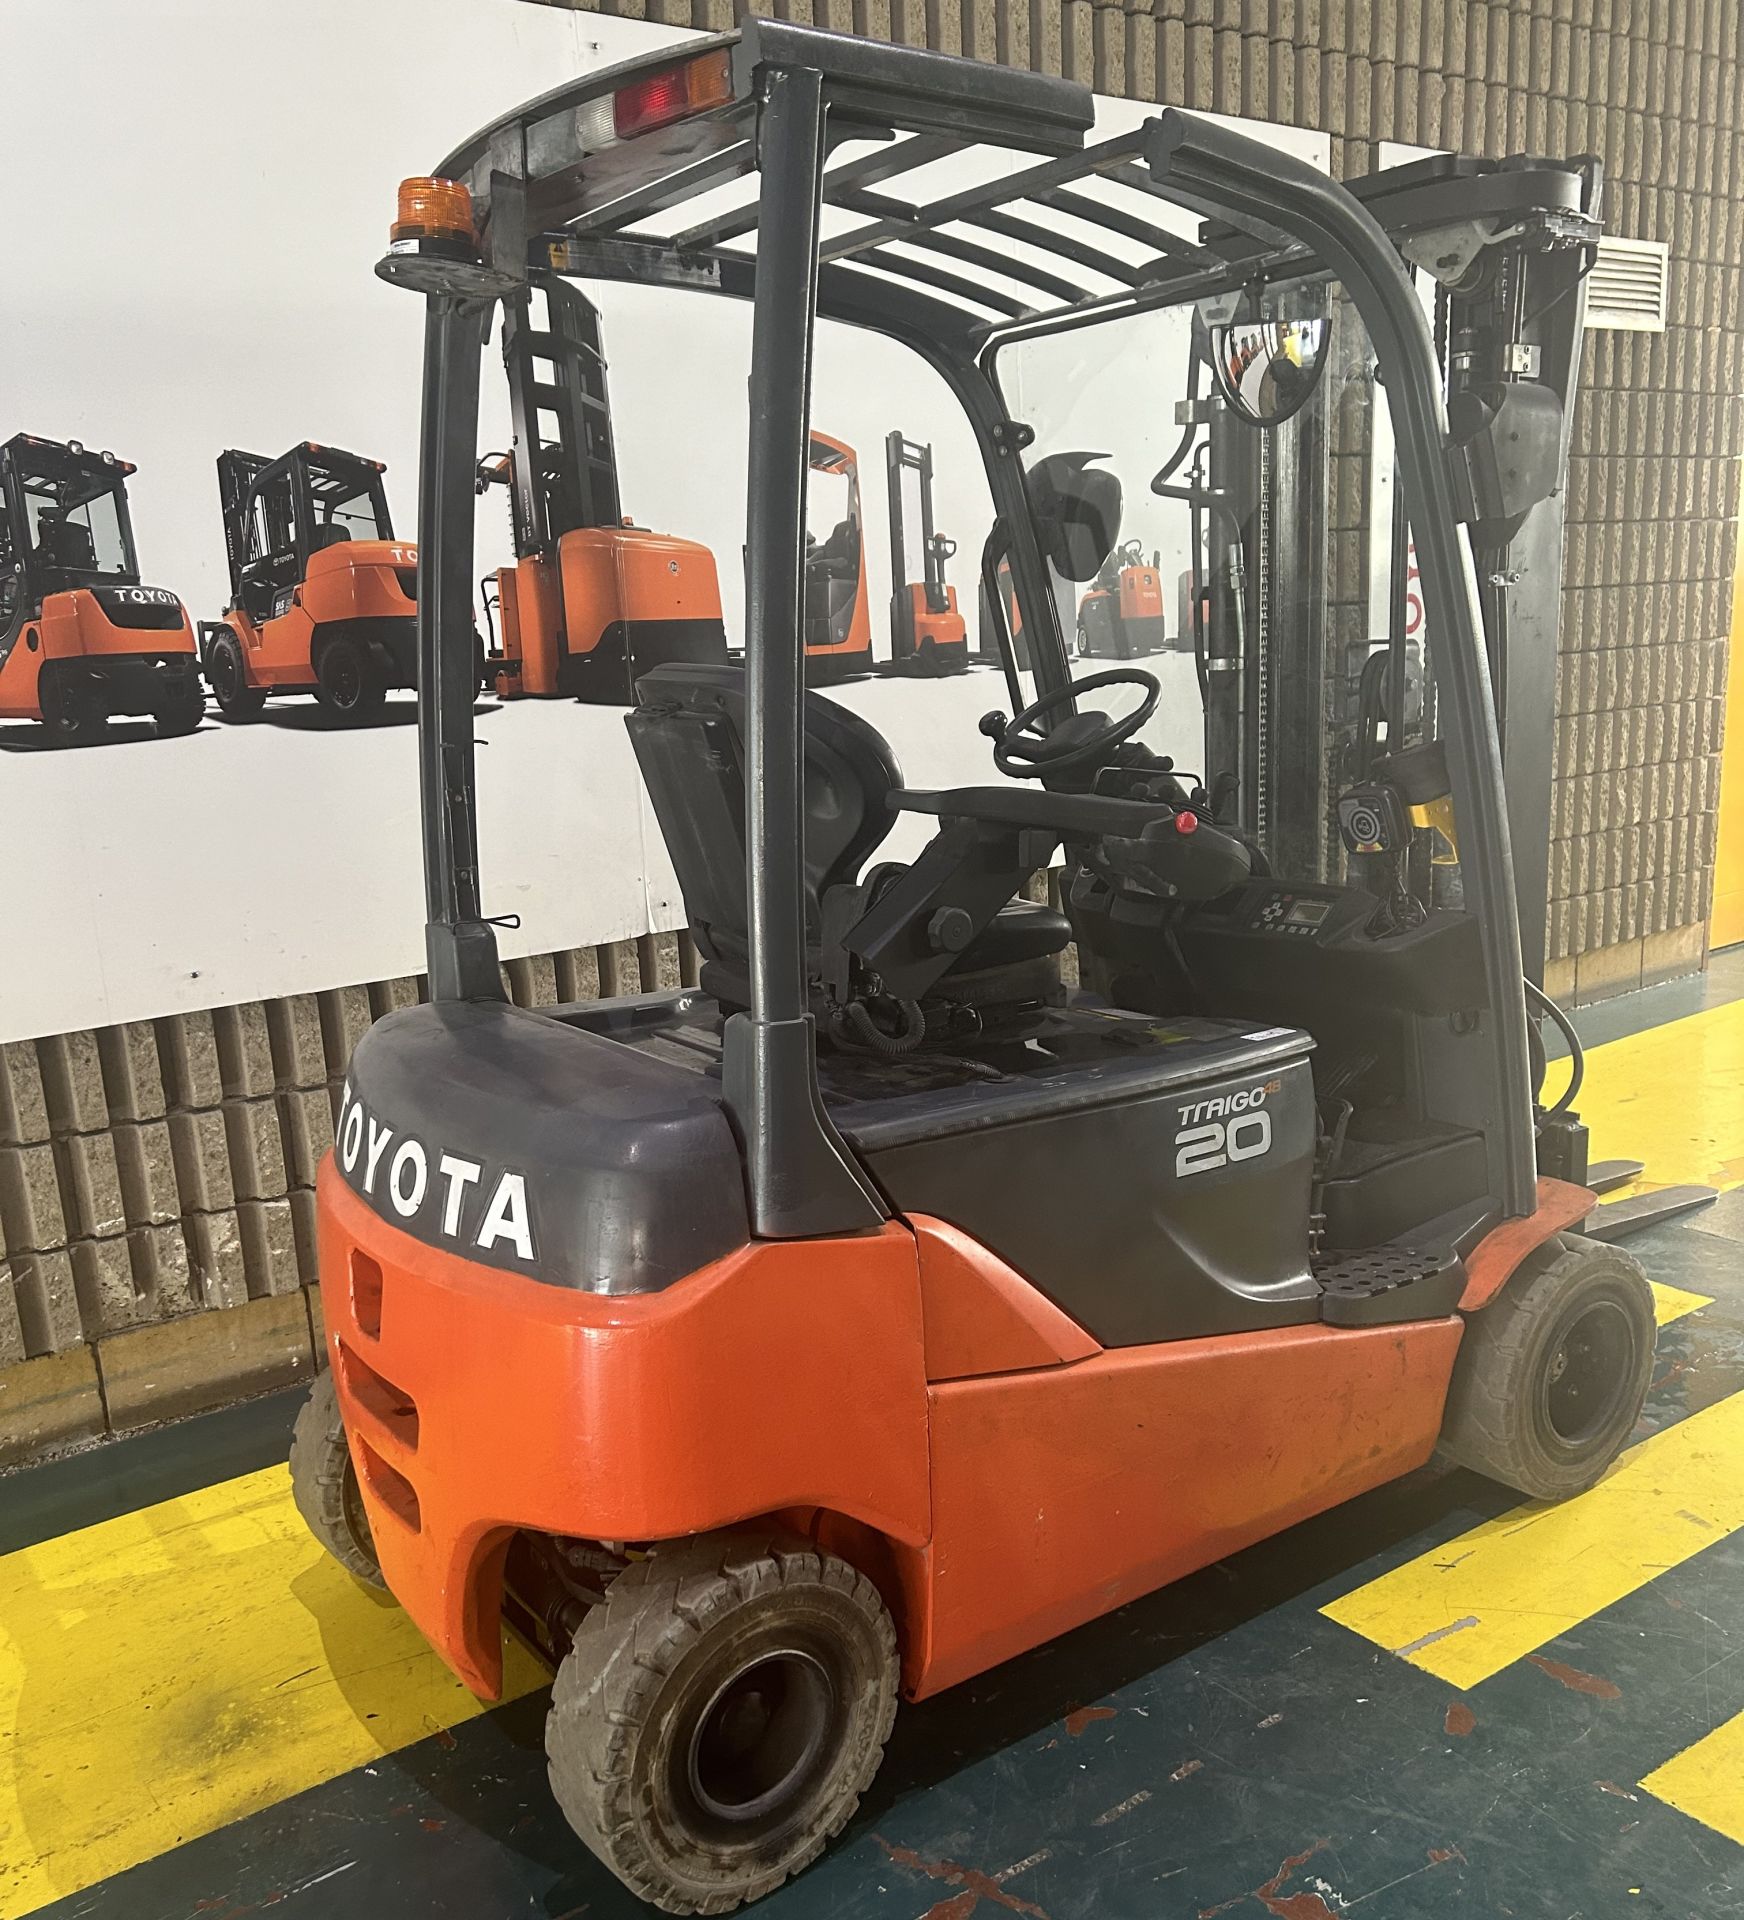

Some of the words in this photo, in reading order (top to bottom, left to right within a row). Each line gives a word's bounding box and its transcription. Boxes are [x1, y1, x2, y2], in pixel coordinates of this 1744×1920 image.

[279, 553, 294, 563] TOYOTA
[114, 589, 179, 606] TOYOTA
[1177, 1086, 1266, 1126] TRAIGO
[1174, 1110, 1272, 1178] 20
[336, 1079, 535, 1261] TOYOTA
